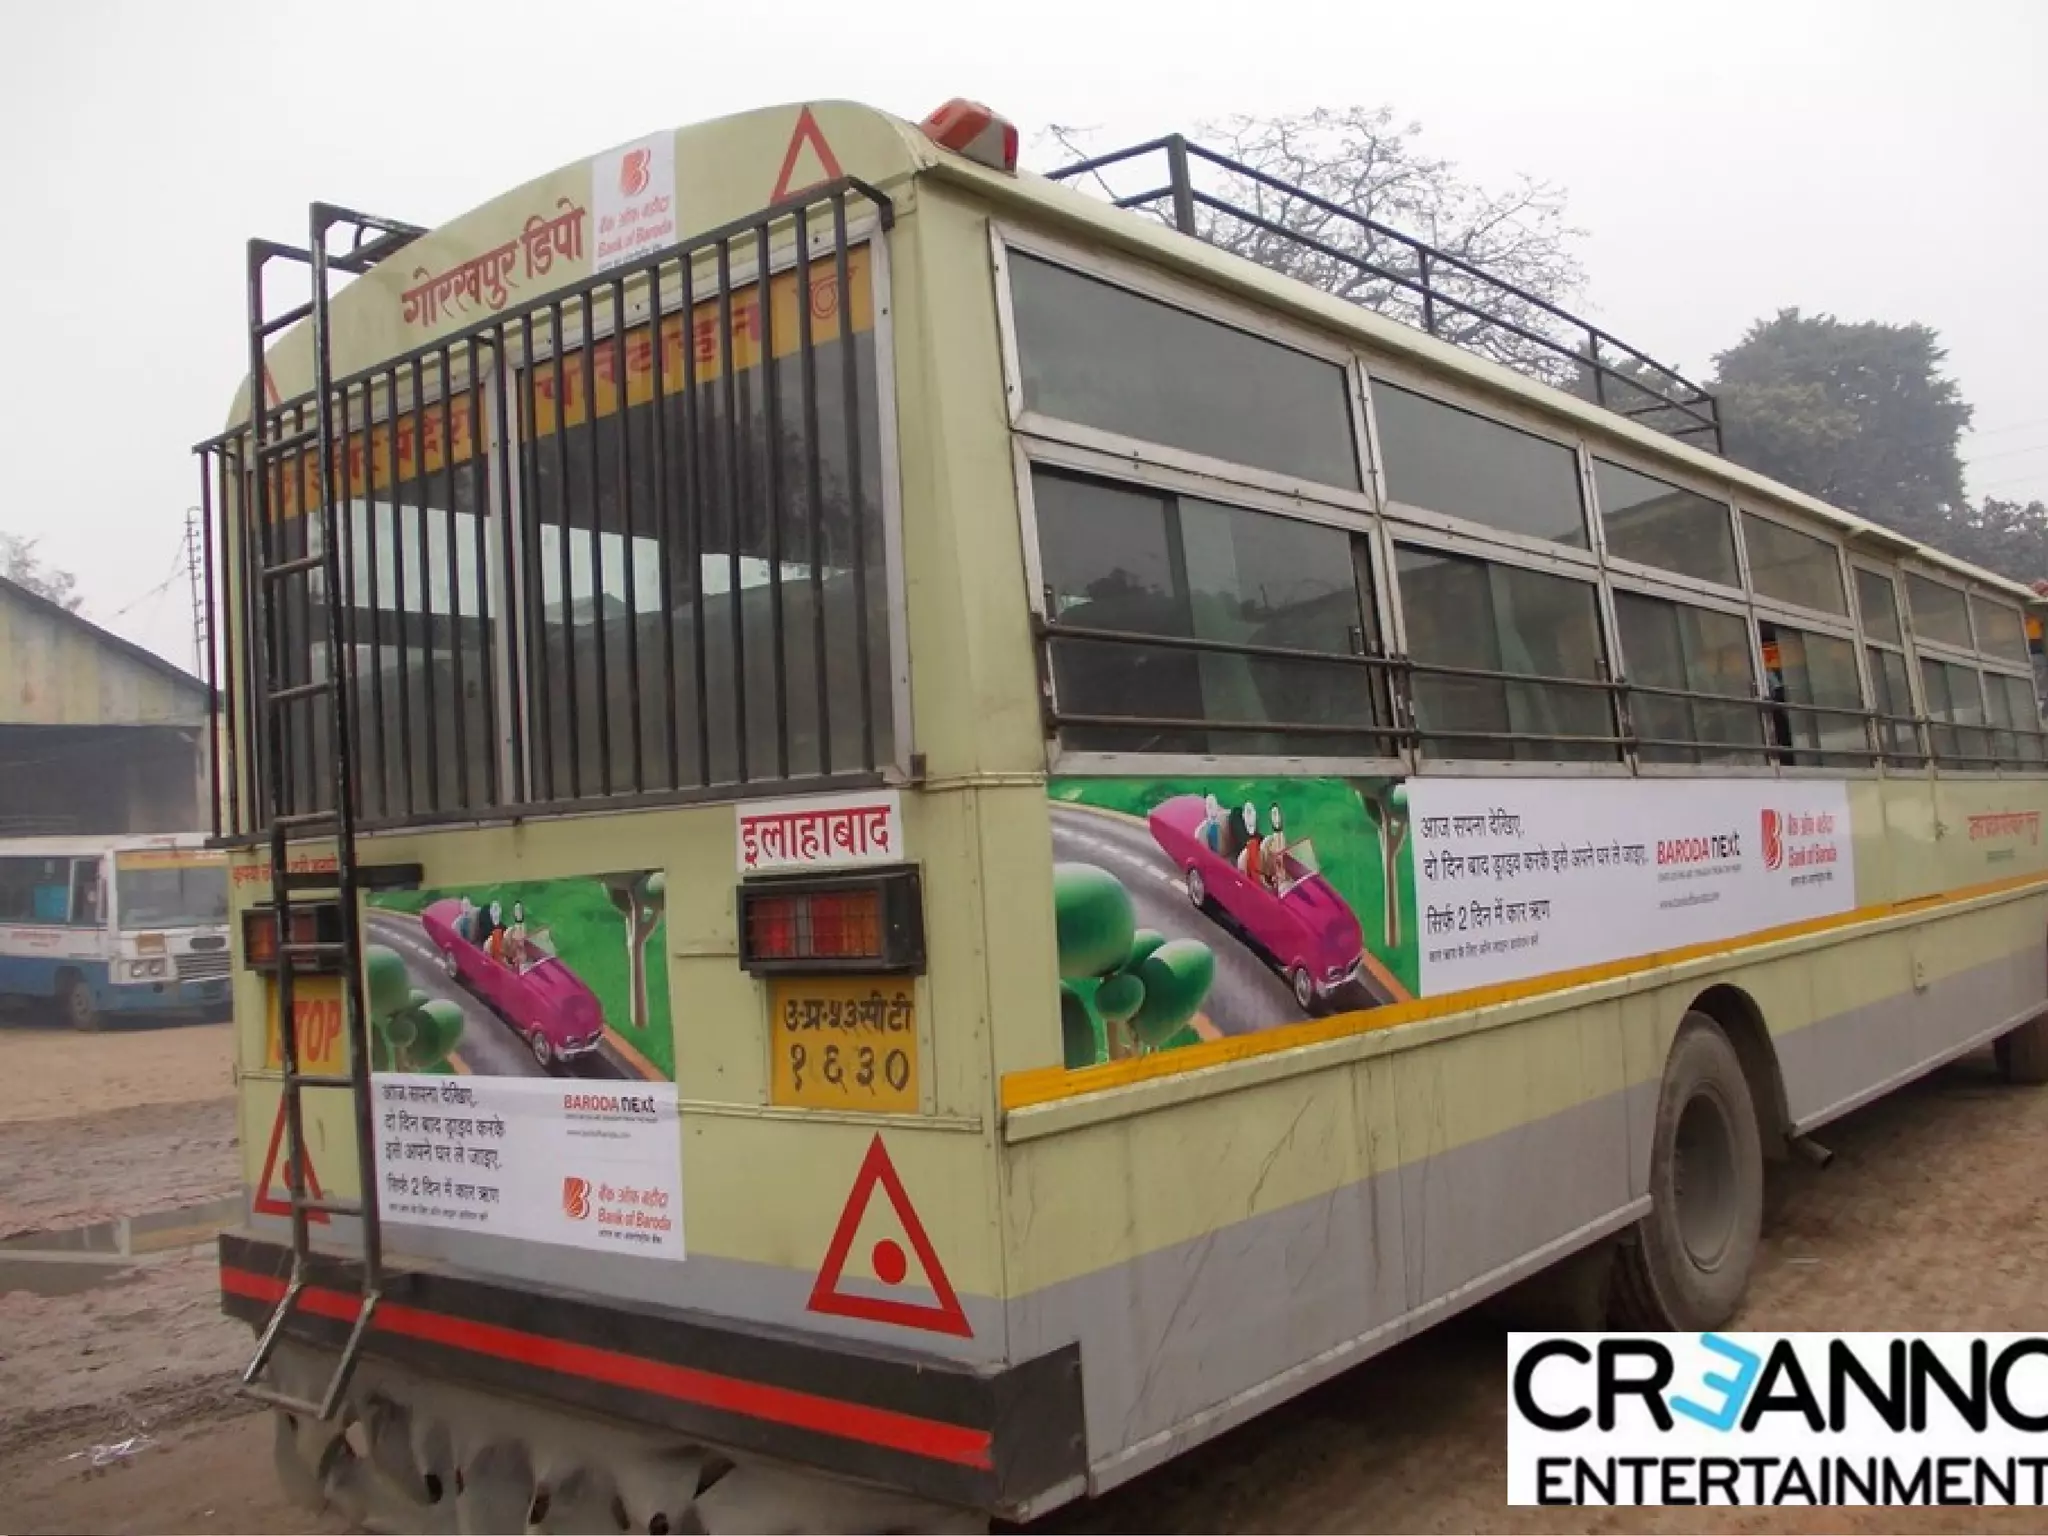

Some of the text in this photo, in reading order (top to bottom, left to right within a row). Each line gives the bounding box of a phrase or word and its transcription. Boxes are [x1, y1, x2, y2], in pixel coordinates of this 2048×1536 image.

[401, 197, 586, 328] गोरखपुर डिपो
[740, 804, 892, 868] इलाहाबाद
[1441, 850, 1465, 880] दिन
[1467, 854, 1490, 876] बाद
[1657, 837, 1710, 865] BARODA
[1788, 846, 1805, 867] Bank
[1815, 842, 1838, 864] Baroda
[1458, 905, 1467, 931] 2
[1470, 900, 1491, 929] दिन
[274, 1000, 342, 1062] TOP
[564, 1094, 619, 1112] BARODA
[411, 1177, 419, 1196] 2
[598, 1207, 672, 1231] Bank of Baroda
